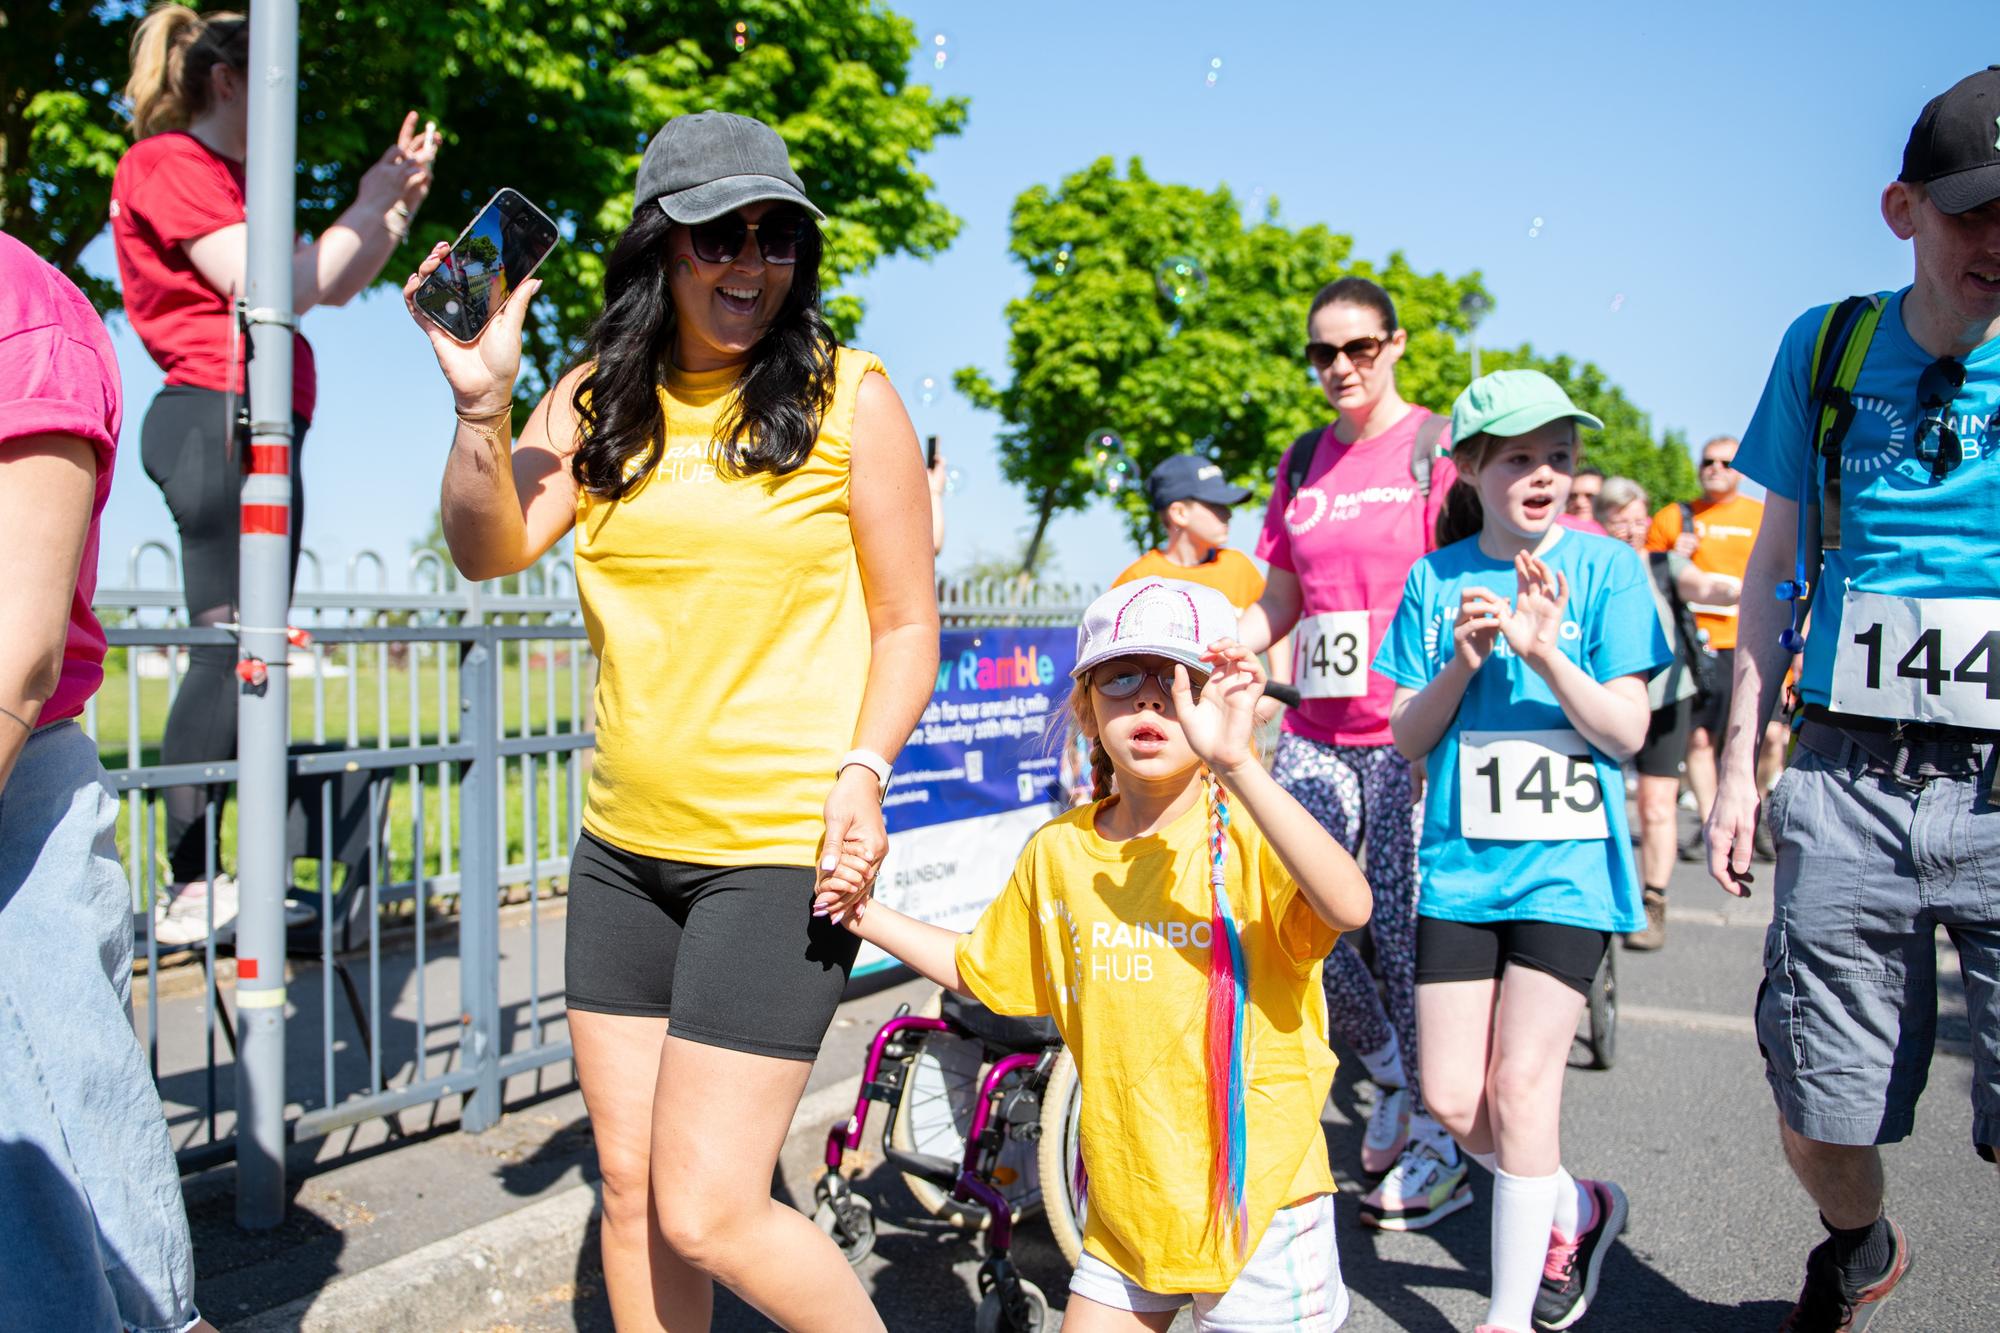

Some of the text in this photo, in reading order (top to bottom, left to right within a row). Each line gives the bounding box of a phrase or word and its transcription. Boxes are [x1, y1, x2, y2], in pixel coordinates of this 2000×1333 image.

[657, 461, 717, 483] HUB
[1333, 486, 1415, 508] RAINBOW
[958, 645, 1055, 691] Ramble
[1302, 632, 1359, 681] 143
[1853, 623, 2000, 700] 144
[1476, 755, 1603, 814] 145
[1092, 921, 1214, 949] RAINBO
[1092, 954, 1153, 982] HUB
